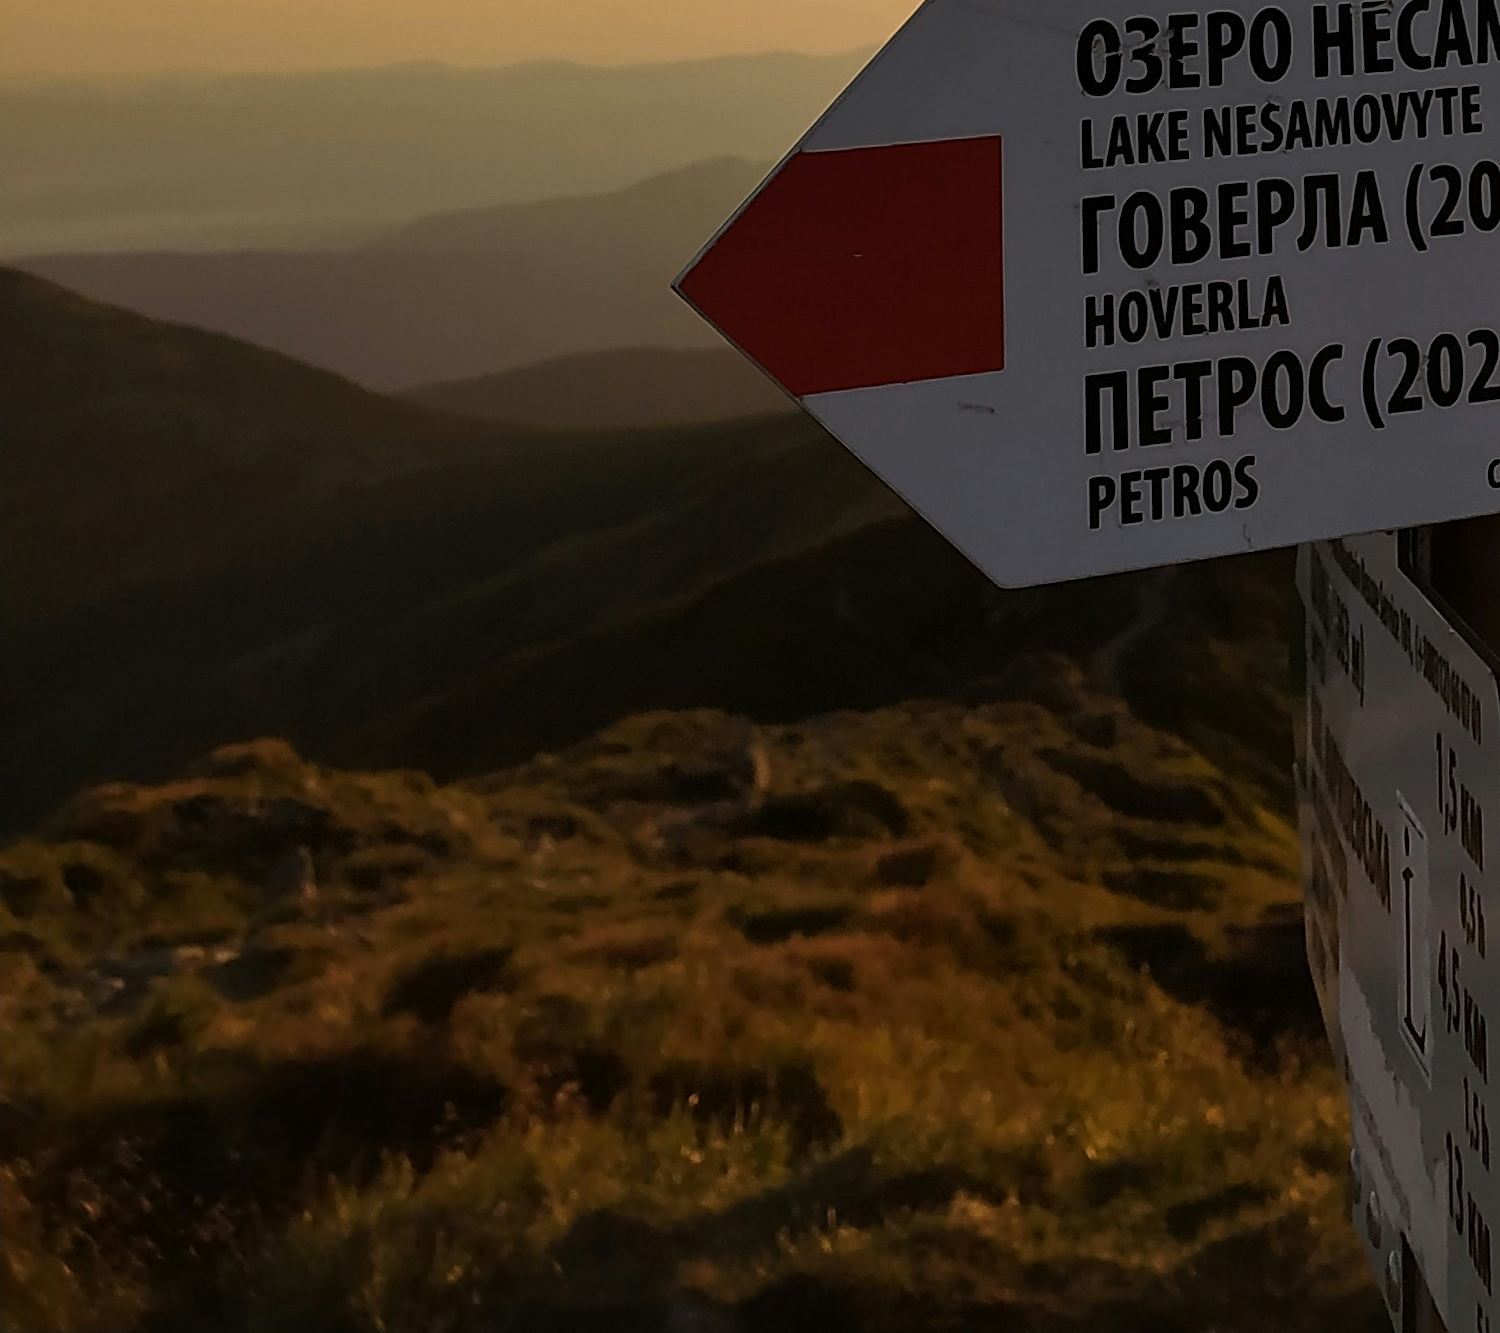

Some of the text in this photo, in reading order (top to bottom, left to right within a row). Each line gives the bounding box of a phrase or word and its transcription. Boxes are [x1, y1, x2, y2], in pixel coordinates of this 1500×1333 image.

[1076, 7, 1292, 97] ОЗЕРО
[1081, 85, 1483, 170] LAKE NESAMOVYTE
[1081, 170, 1389, 275] ГОВЕРЛА
[1085, 275, 1290, 348] HOVERLA
[1084, 343, 1345, 455] ПЕТРОС
[1088, 455, 1259, 530] PETROS
[1436, 733, 1458, 837] 1,5
